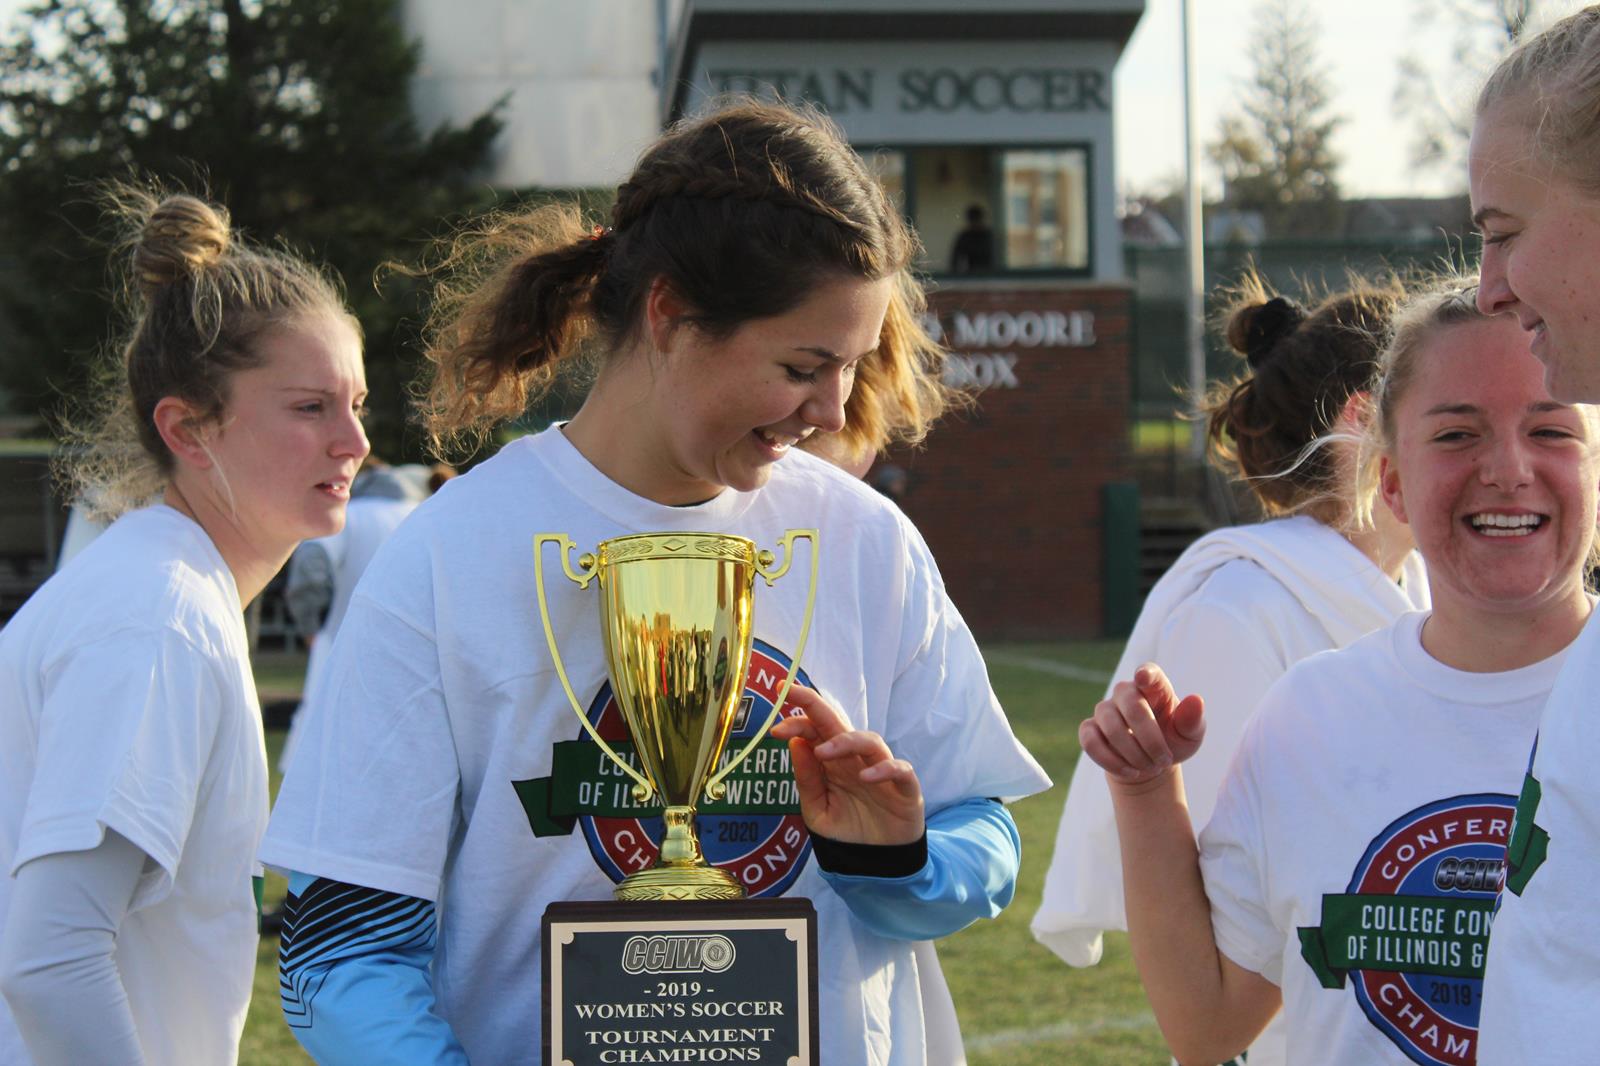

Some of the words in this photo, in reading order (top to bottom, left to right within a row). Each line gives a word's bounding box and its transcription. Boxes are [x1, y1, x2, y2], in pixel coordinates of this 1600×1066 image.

[902, 68, 1111, 112] SOCCER
[953, 311, 1097, 347] MOORE
[579, 782, 604, 806] OF
[719, 821, 758, 843] 2020
[1382, 819, 1508, 880] CONFER
[1362, 905, 1445, 935] COLLEGE
[1348, 936, 1368, 960] OF
[1376, 938, 1461, 967] ILLINOIS
[1471, 943, 1484, 968] &
[657, 982, 701, 997] 2019
[1431, 982, 1472, 1006] 2019
[575, 1003, 686, 1019] WOMEN'S
[691, 1001, 784, 1017] SOCCER
[585, 1028, 775, 1045] TOURNAMENT
[600, 1047, 761, 1063] CHAMPIONS
